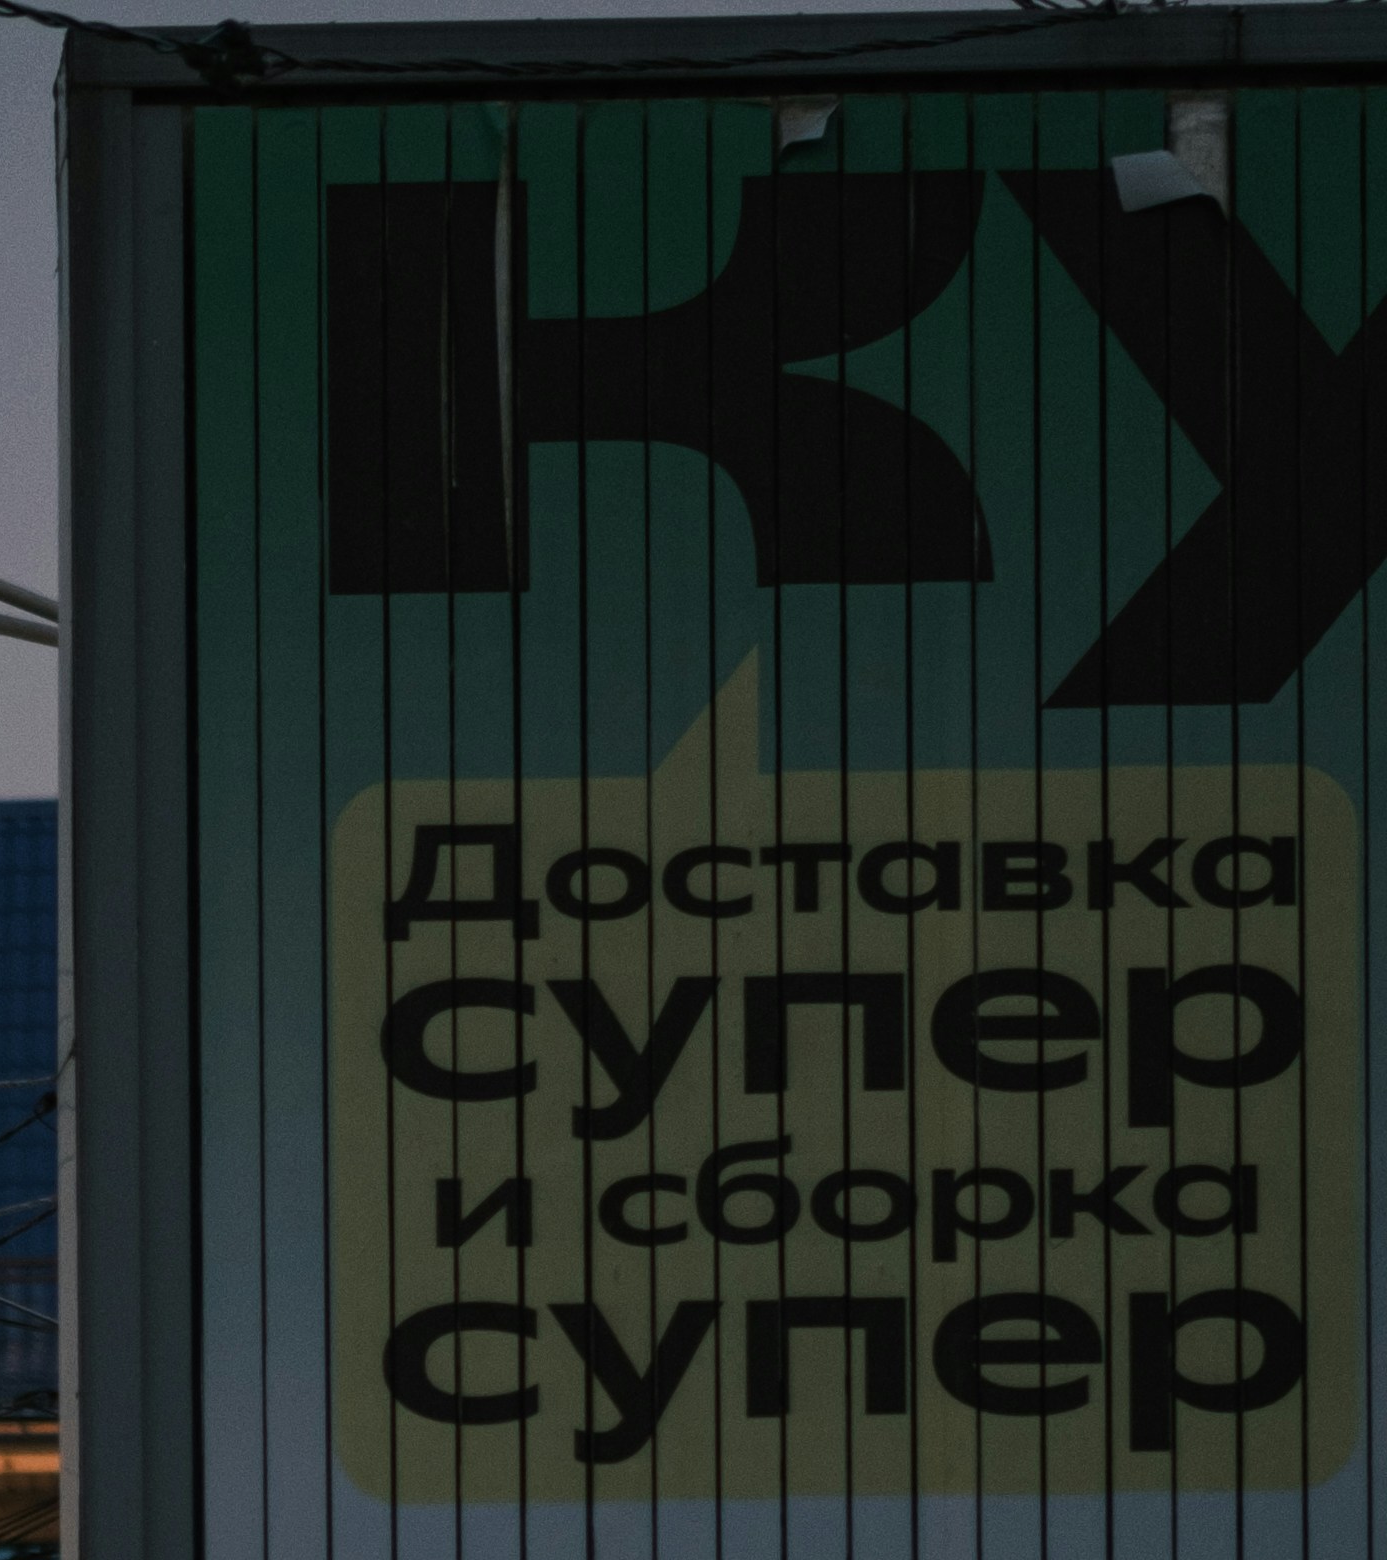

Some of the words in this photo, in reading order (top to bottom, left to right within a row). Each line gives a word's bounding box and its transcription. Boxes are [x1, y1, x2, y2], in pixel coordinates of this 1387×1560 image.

[383, 822, 1299, 942] Доставка
[379, 962, 1305, 1140] супер
[435, 1177, 535, 1248] и
[598, 1134, 1259, 1263] сборка
[383, 1286, 1307, 1465] супер
